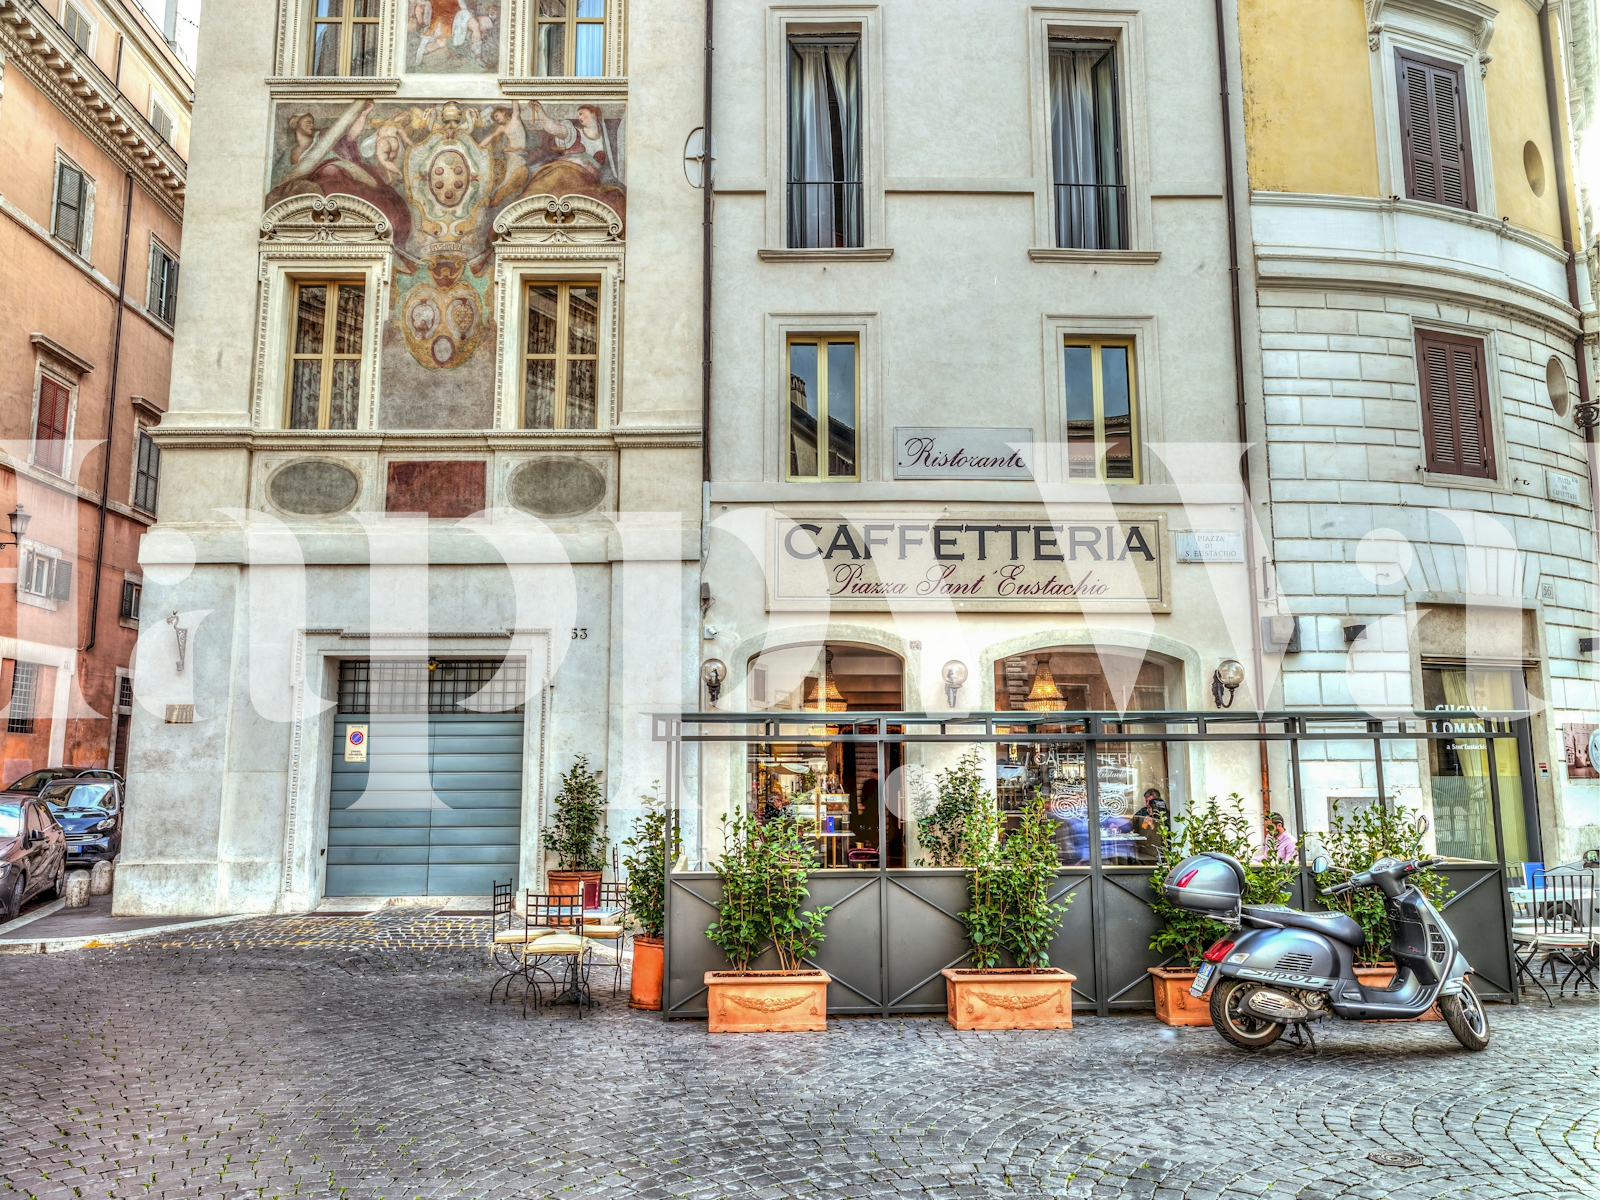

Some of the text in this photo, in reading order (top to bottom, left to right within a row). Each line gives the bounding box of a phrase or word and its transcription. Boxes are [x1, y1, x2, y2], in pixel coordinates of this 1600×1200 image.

[899, 437, 1026, 468] Ristorante
[784, 523, 1156, 562] CAFFETTERIA
[826, 563, 908, 595] Piazza
[1543, 585, 1552, 597] 56
[1033, 753, 1144, 766] CAFFETERIA
